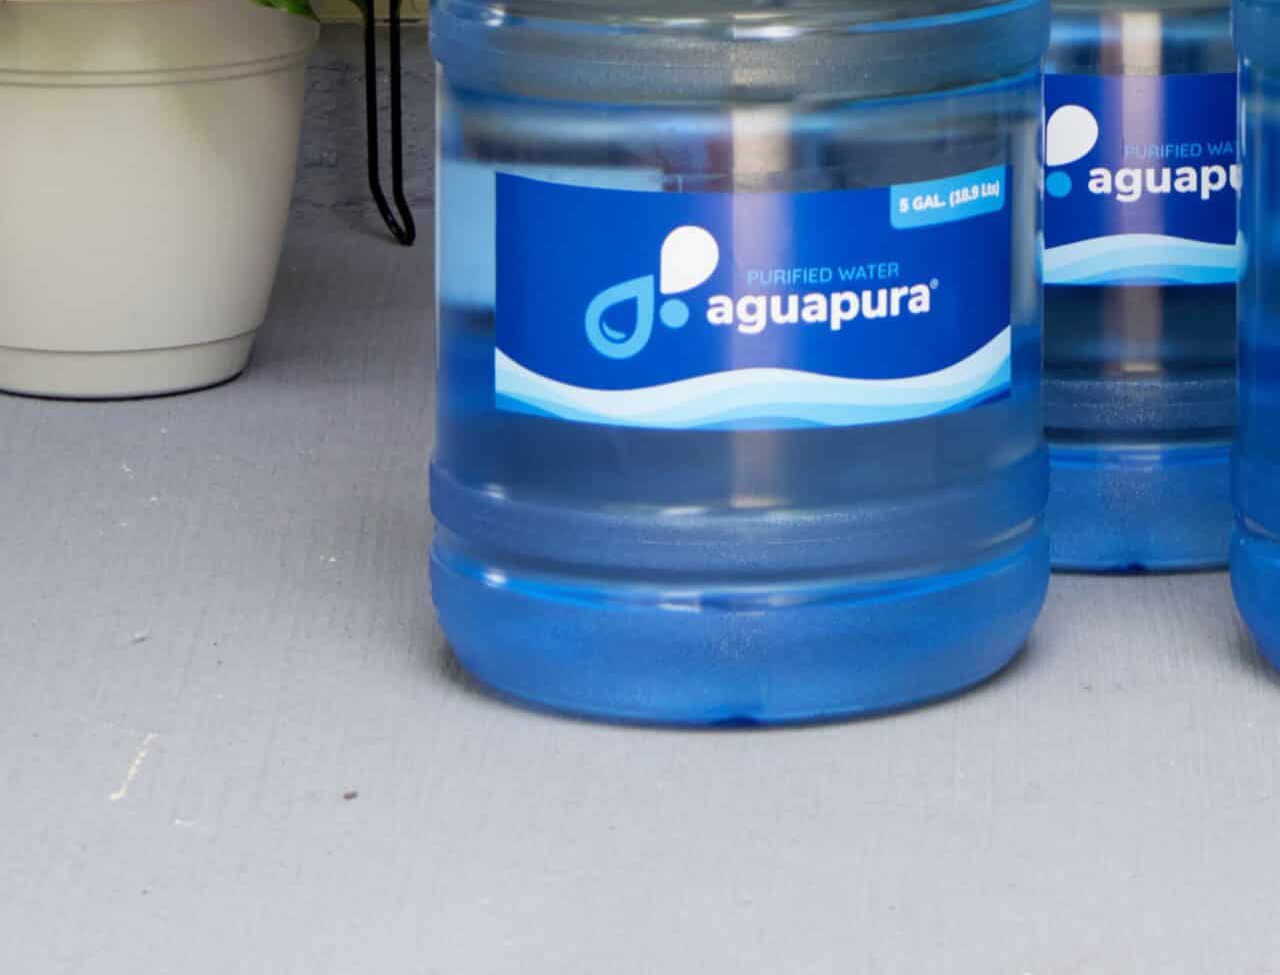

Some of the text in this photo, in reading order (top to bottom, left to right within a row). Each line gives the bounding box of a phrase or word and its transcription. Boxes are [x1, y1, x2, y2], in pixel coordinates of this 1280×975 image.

[1124, 143, 1202, 159] PURIFIED
[1088, 164, 1241, 202] aguap
[899, 197, 909, 213] 5
[912, 193, 946, 211] GAL.
[746, 262, 900, 285] PURIFIED WATER
